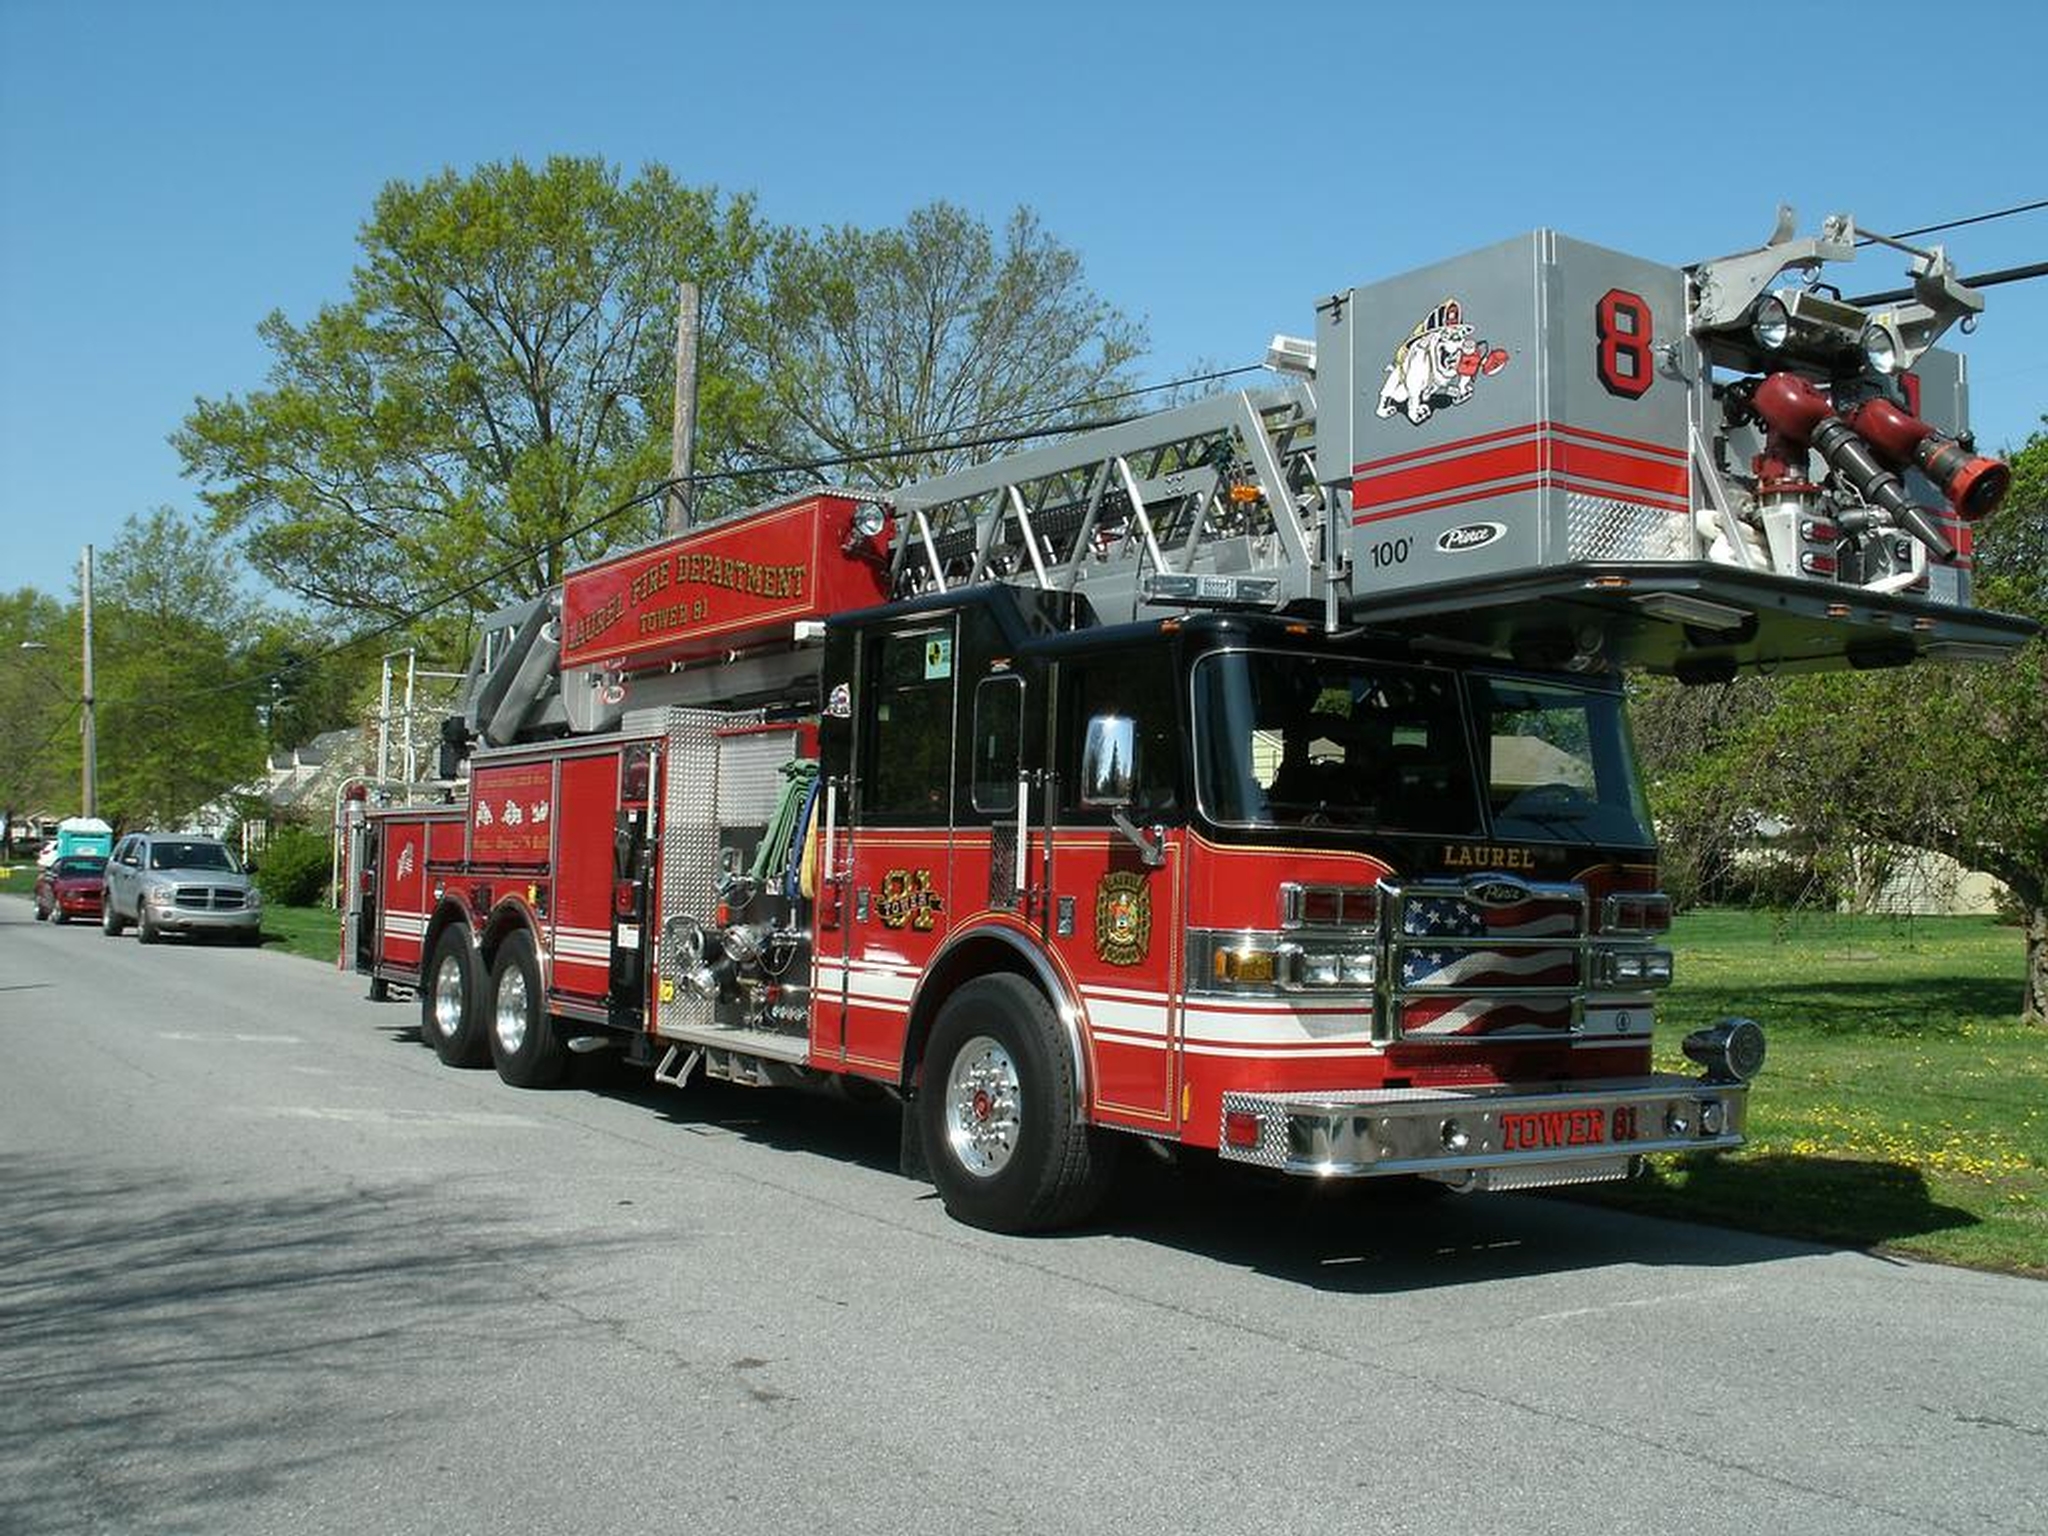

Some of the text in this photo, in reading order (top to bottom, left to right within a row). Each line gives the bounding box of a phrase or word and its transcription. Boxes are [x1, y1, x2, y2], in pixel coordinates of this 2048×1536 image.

[1595, 287, 1654, 401] 8
[1447, 525, 1491, 548] Pierce
[630, 560, 671, 606] FIRE
[675, 554, 806, 599] DEPARTMENT
[639, 597, 710, 634] TOWER 81
[1443, 844, 1536, 869] LAUREL
[1499, 1108, 1605, 1150] TOWER
